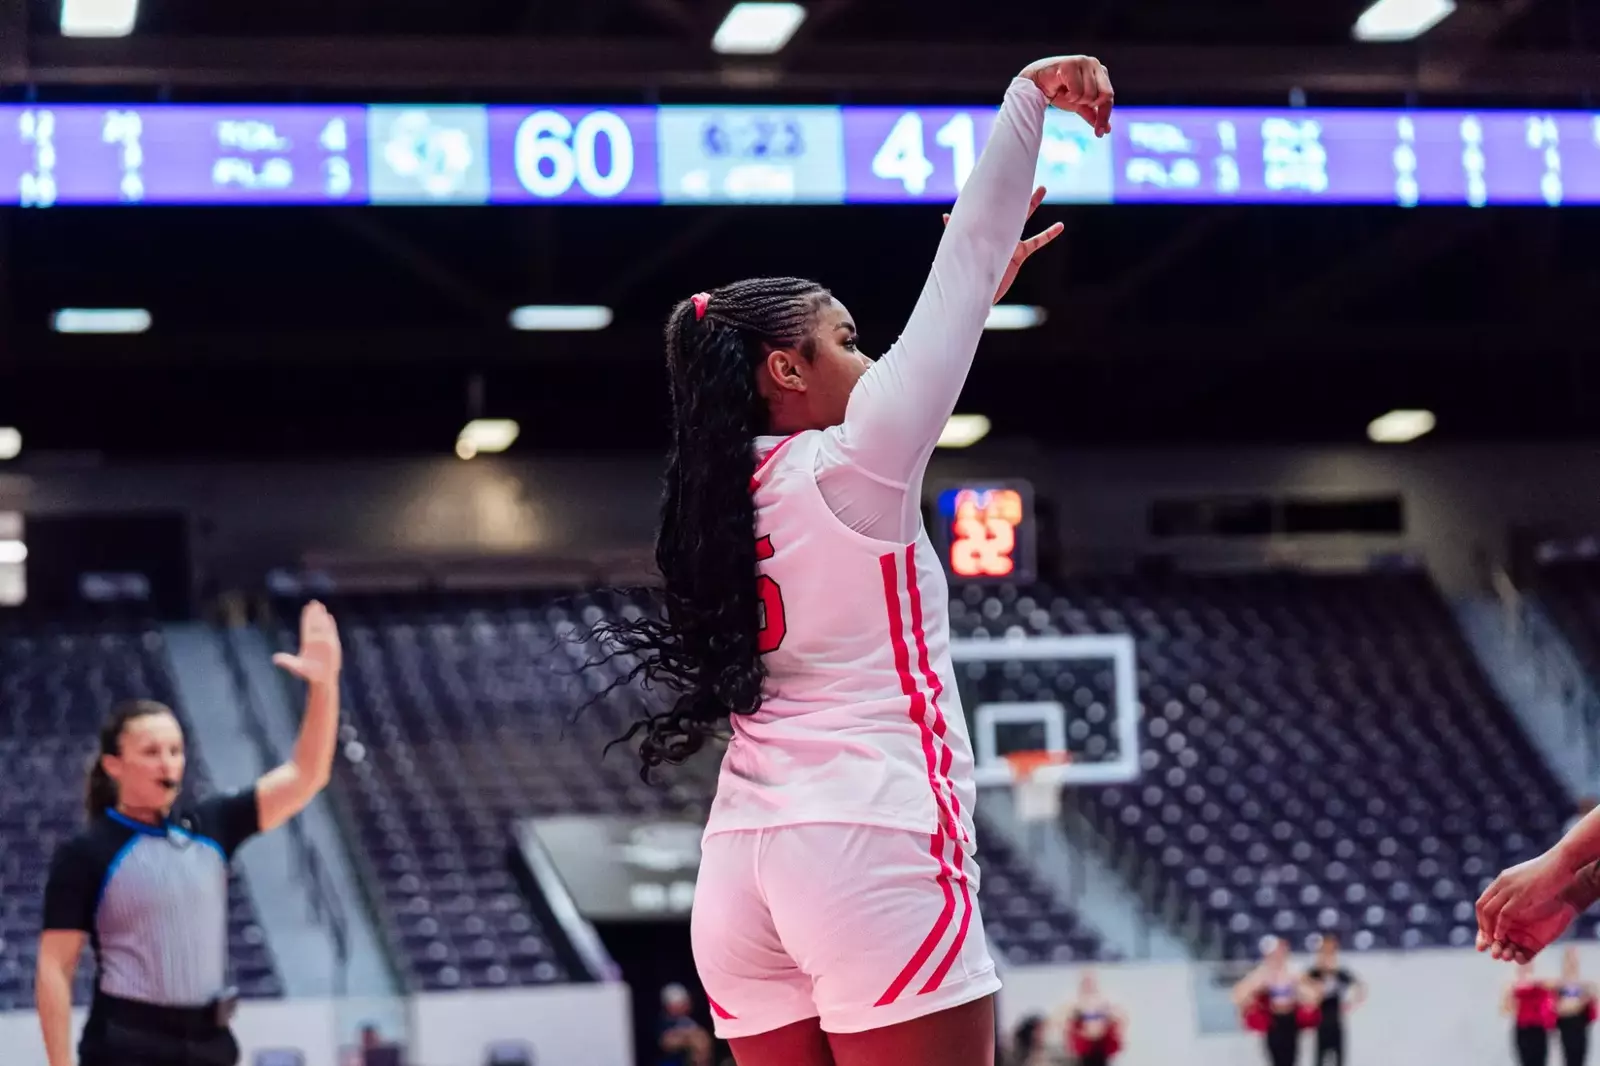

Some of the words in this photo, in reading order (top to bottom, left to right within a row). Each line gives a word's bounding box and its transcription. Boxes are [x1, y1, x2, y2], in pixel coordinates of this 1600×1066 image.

[514, 109, 634, 198] 60
[872, 111, 976, 196] 41
[949, 518, 1016, 577] 22
